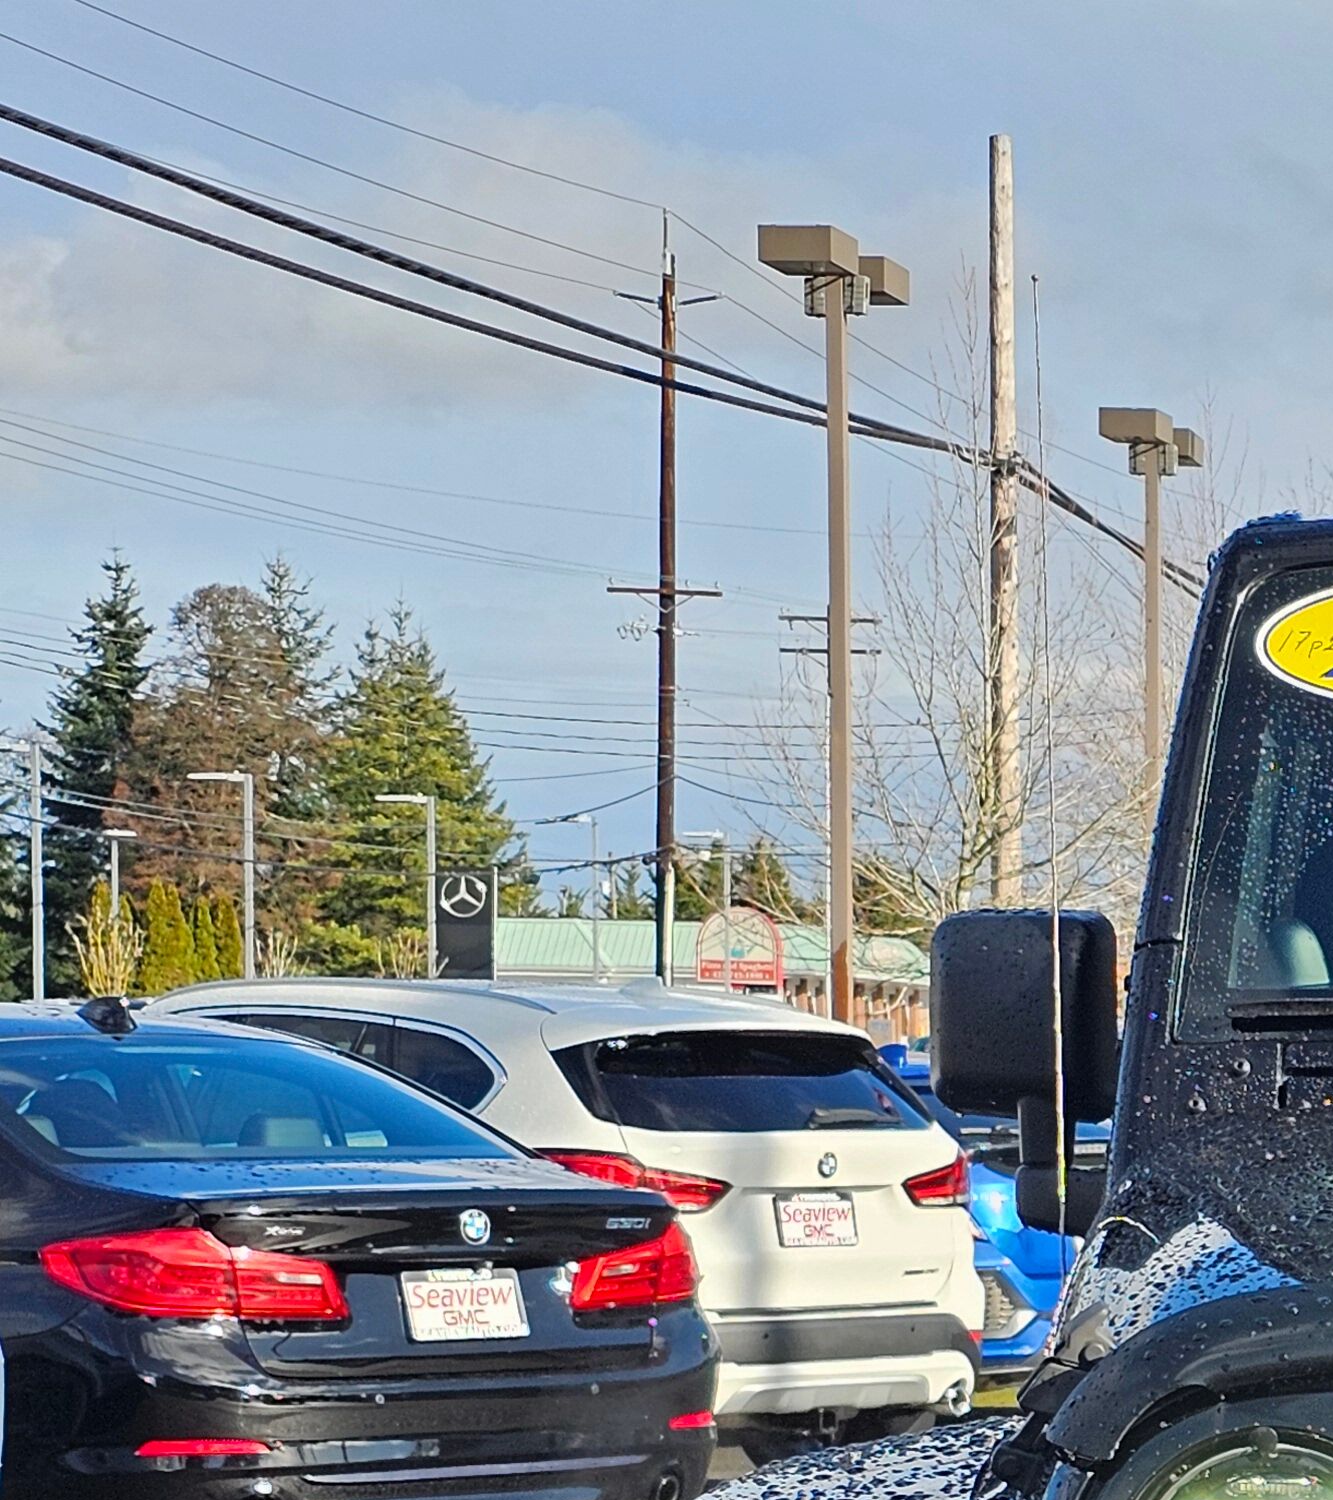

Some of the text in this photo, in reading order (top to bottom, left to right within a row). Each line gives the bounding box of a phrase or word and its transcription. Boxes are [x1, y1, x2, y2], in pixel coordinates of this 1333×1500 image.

[781, 1203, 851, 1222] Seaview
[410, 1282, 512, 1309] Seaview
[443, 1309, 490, 1326] GMC
